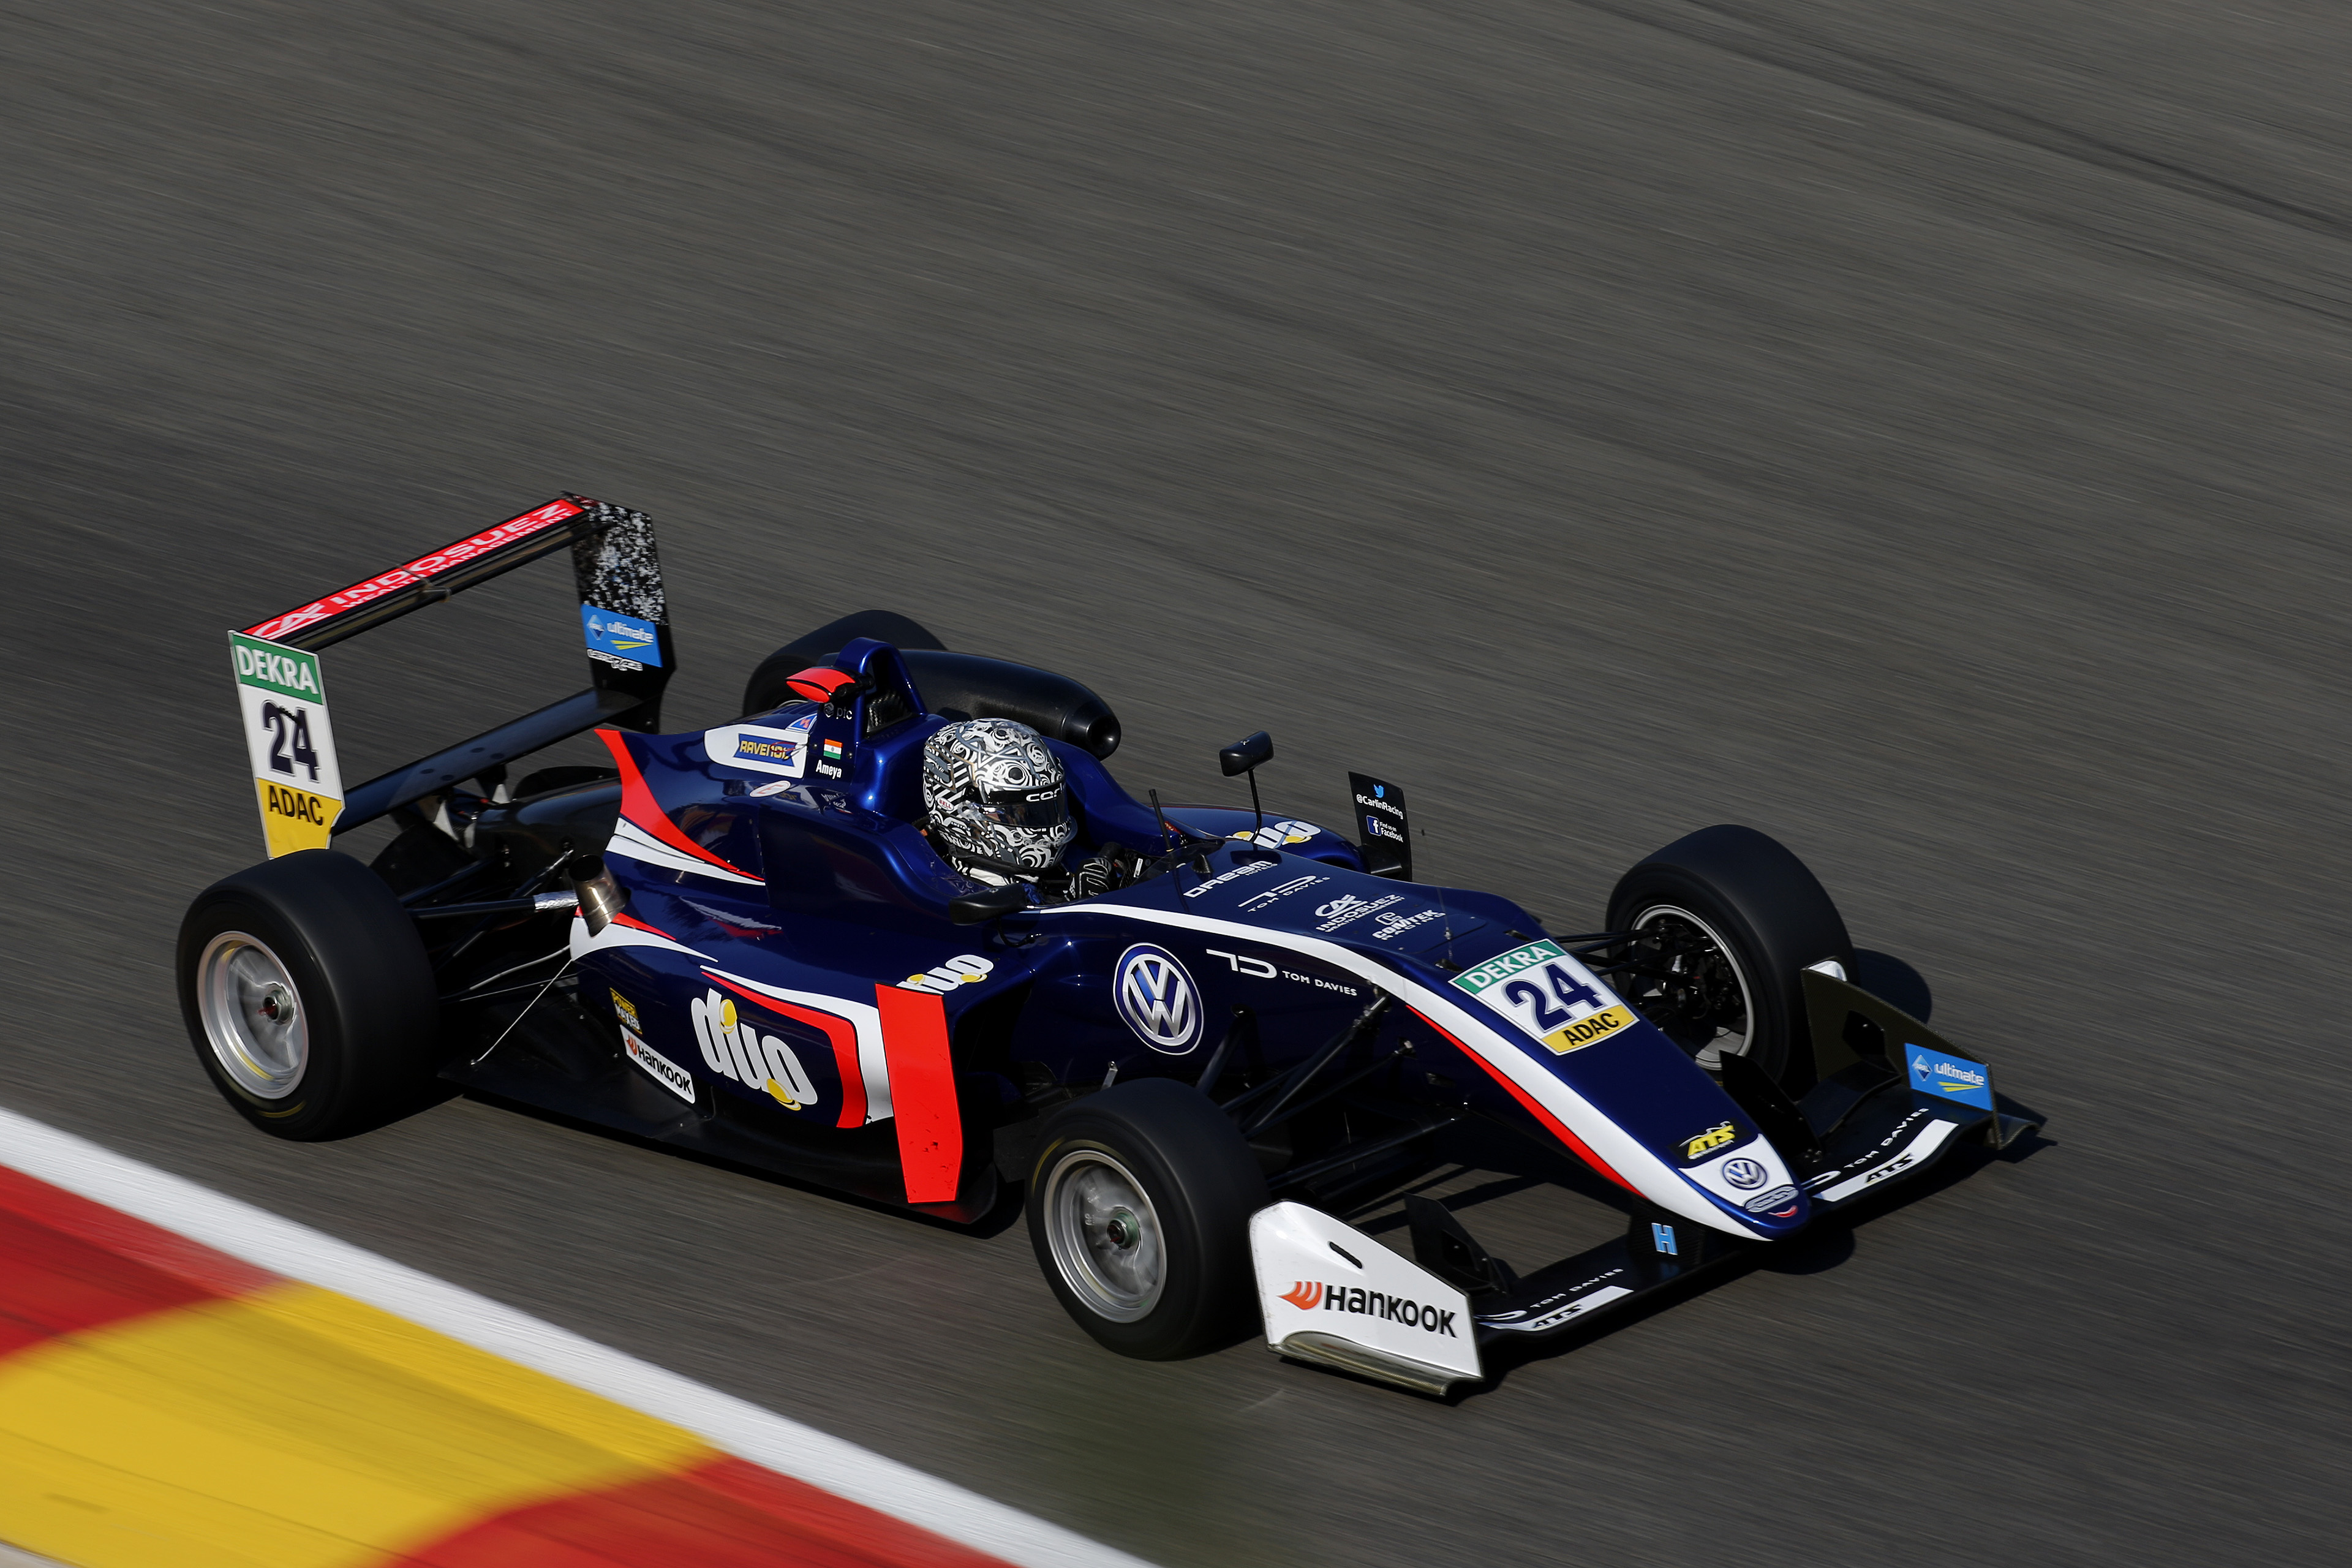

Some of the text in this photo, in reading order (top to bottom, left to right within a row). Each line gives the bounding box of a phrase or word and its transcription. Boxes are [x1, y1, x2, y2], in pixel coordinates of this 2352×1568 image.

[329, 504, 568, 605] INDOSUEZ
[430, 511, 573, 573] MANAGEMENT
[607, 621, 654, 643] ultimate
[235, 645, 319, 695] DEKRA
[836, 706, 853, 720] ptc
[261, 699, 321, 783] 24
[815, 760, 842, 779] Ameya
[269, 785, 323, 826] ADAC
[939, 799, 952, 809] BELL
[1356, 794, 1403, 820] @CarlinRacing
[1381, 827, 1404, 843] Facebook
[1245, 863, 1278, 876] HOTELS
[1247, 876, 1330, 912] TOM DAVIES
[1316, 894, 1401, 931] INDOSUEZ
[1372, 910, 1438, 939] COMTEK
[1381, 913, 1446, 941] RACING
[1282, 970, 1358, 997] TOM DAVIES
[1464, 946, 1558, 989] DEKRA
[1501, 962, 1607, 1033] 24
[1563, 1012, 1619, 1046] ADAC
[1934, 1062, 1985, 1085] ultimate
[1687, 1125, 1735, 1156] ATS
[1844, 1150, 1880, 1168] TOM
[1880, 1108, 1929, 1146] DAVIES
[1651, 1223, 1678, 1256] H
[1529, 1293, 1567, 1308] TOM
[1569, 1268, 1624, 1292] DAVIES
